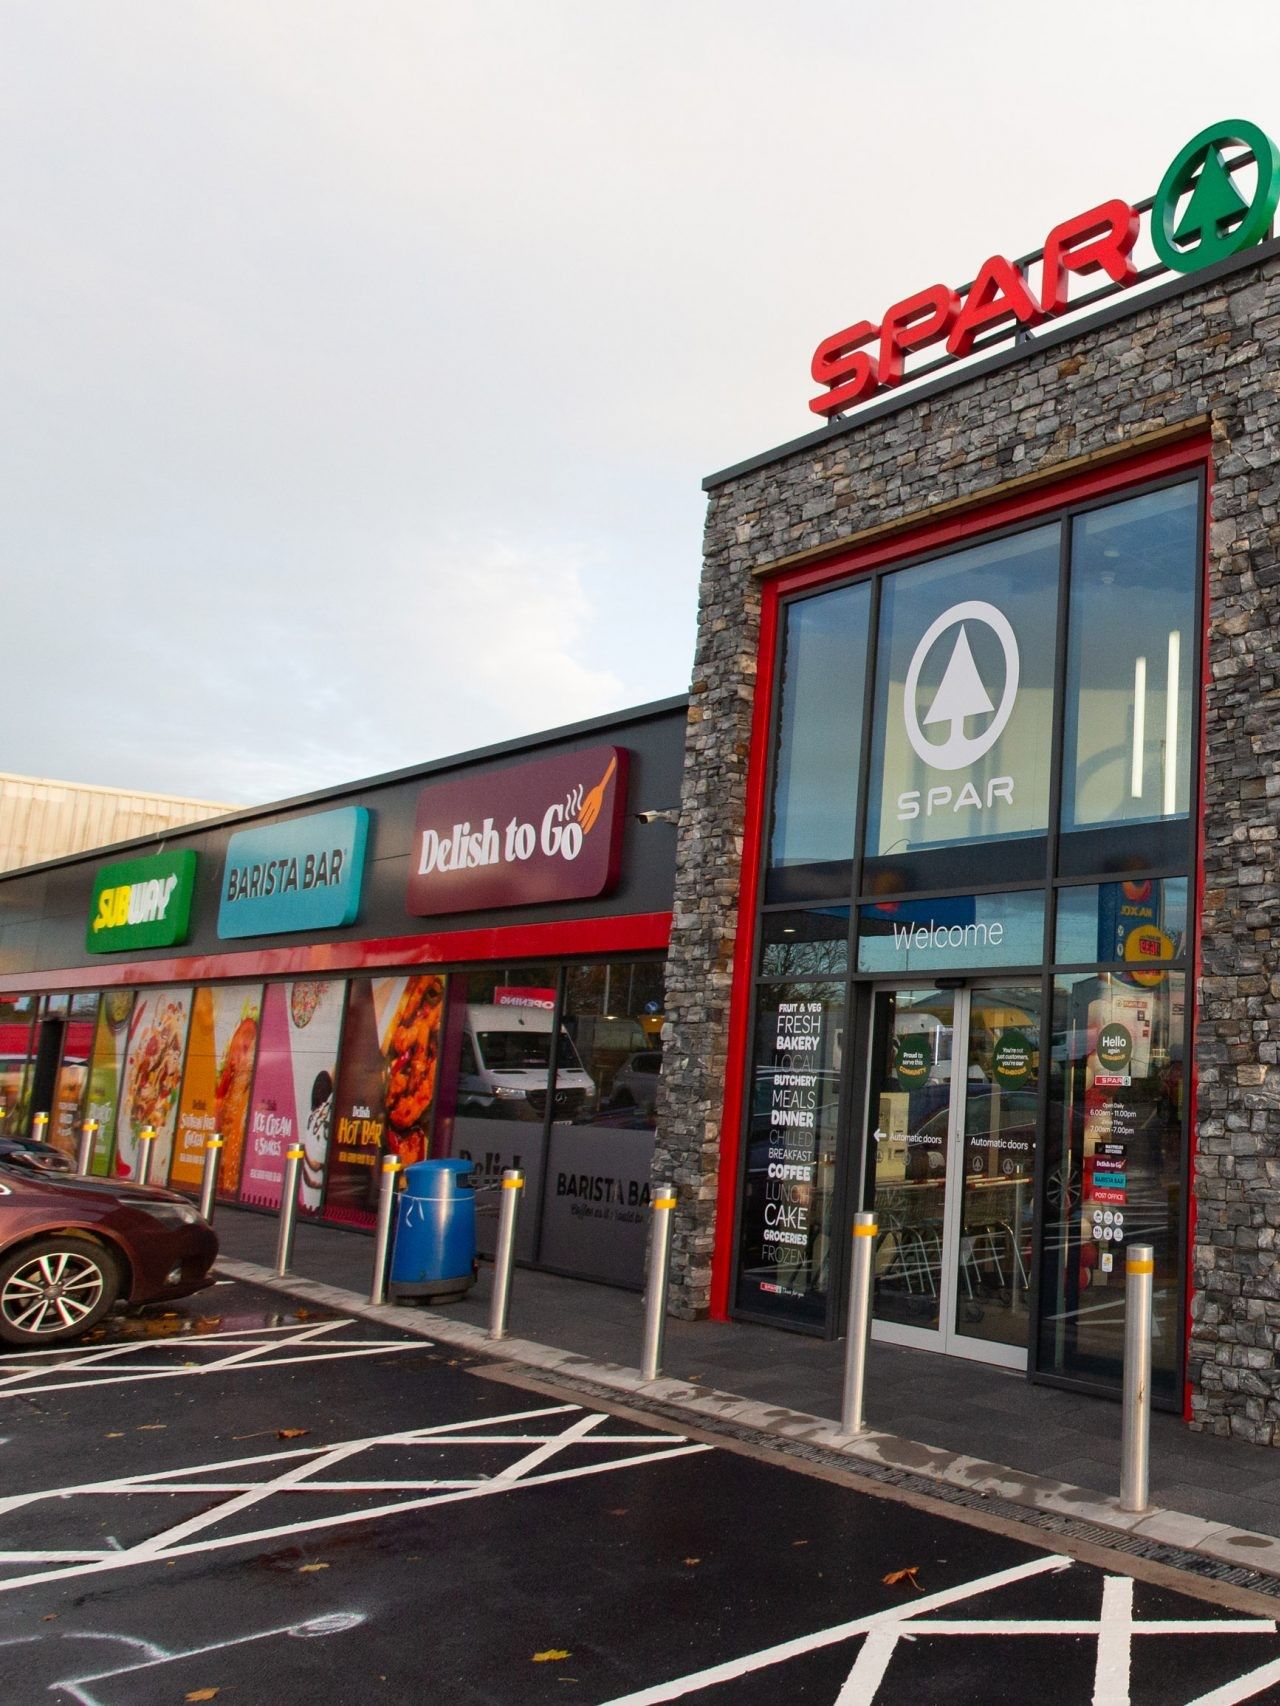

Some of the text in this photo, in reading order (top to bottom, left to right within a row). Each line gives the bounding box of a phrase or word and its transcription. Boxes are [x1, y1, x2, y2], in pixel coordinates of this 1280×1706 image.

[809, 199, 1140, 416] SPAR
[897, 776, 1014, 820] SPAR
[418, 803, 583, 874] Delish to Go
[227, 848, 345, 902] BARISTA BAR
[93, 872, 178, 933] SUBWAY
[894, 919, 1003, 950] Welcome
[779, 1003, 822, 1013] FRUIT & VEG
[777, 1015, 821, 1034] FRESH
[776, 1036, 819, 1050] BAKERY
[1102, 1036, 1126, 1047] Hello
[774, 1075, 817, 1087] BUTCHERY
[772, 1089, 816, 1109] MEALS
[253, 1111, 292, 1138] ICE CREAM
[771, 1110, 813, 1128] DINNER
[338, 1117, 384, 1148] HOT BAR
[769, 1129, 813, 1147] CHILLED
[890, 1134, 942, 1144] Automatic doors
[971, 1137, 1029, 1150] Automatic doors
[768, 1147, 812, 1161] BREAKFAST
[768, 1162, 811, 1182] COFFEE
[556, 1173, 651, 1207] BARISTA BA
[766, 1182, 810, 1205] LUNCH
[764, 1203, 808, 1230] CAKE
[763, 1229, 808, 1245] GROCERIES
[762, 1244, 807, 1266] FROZEN
